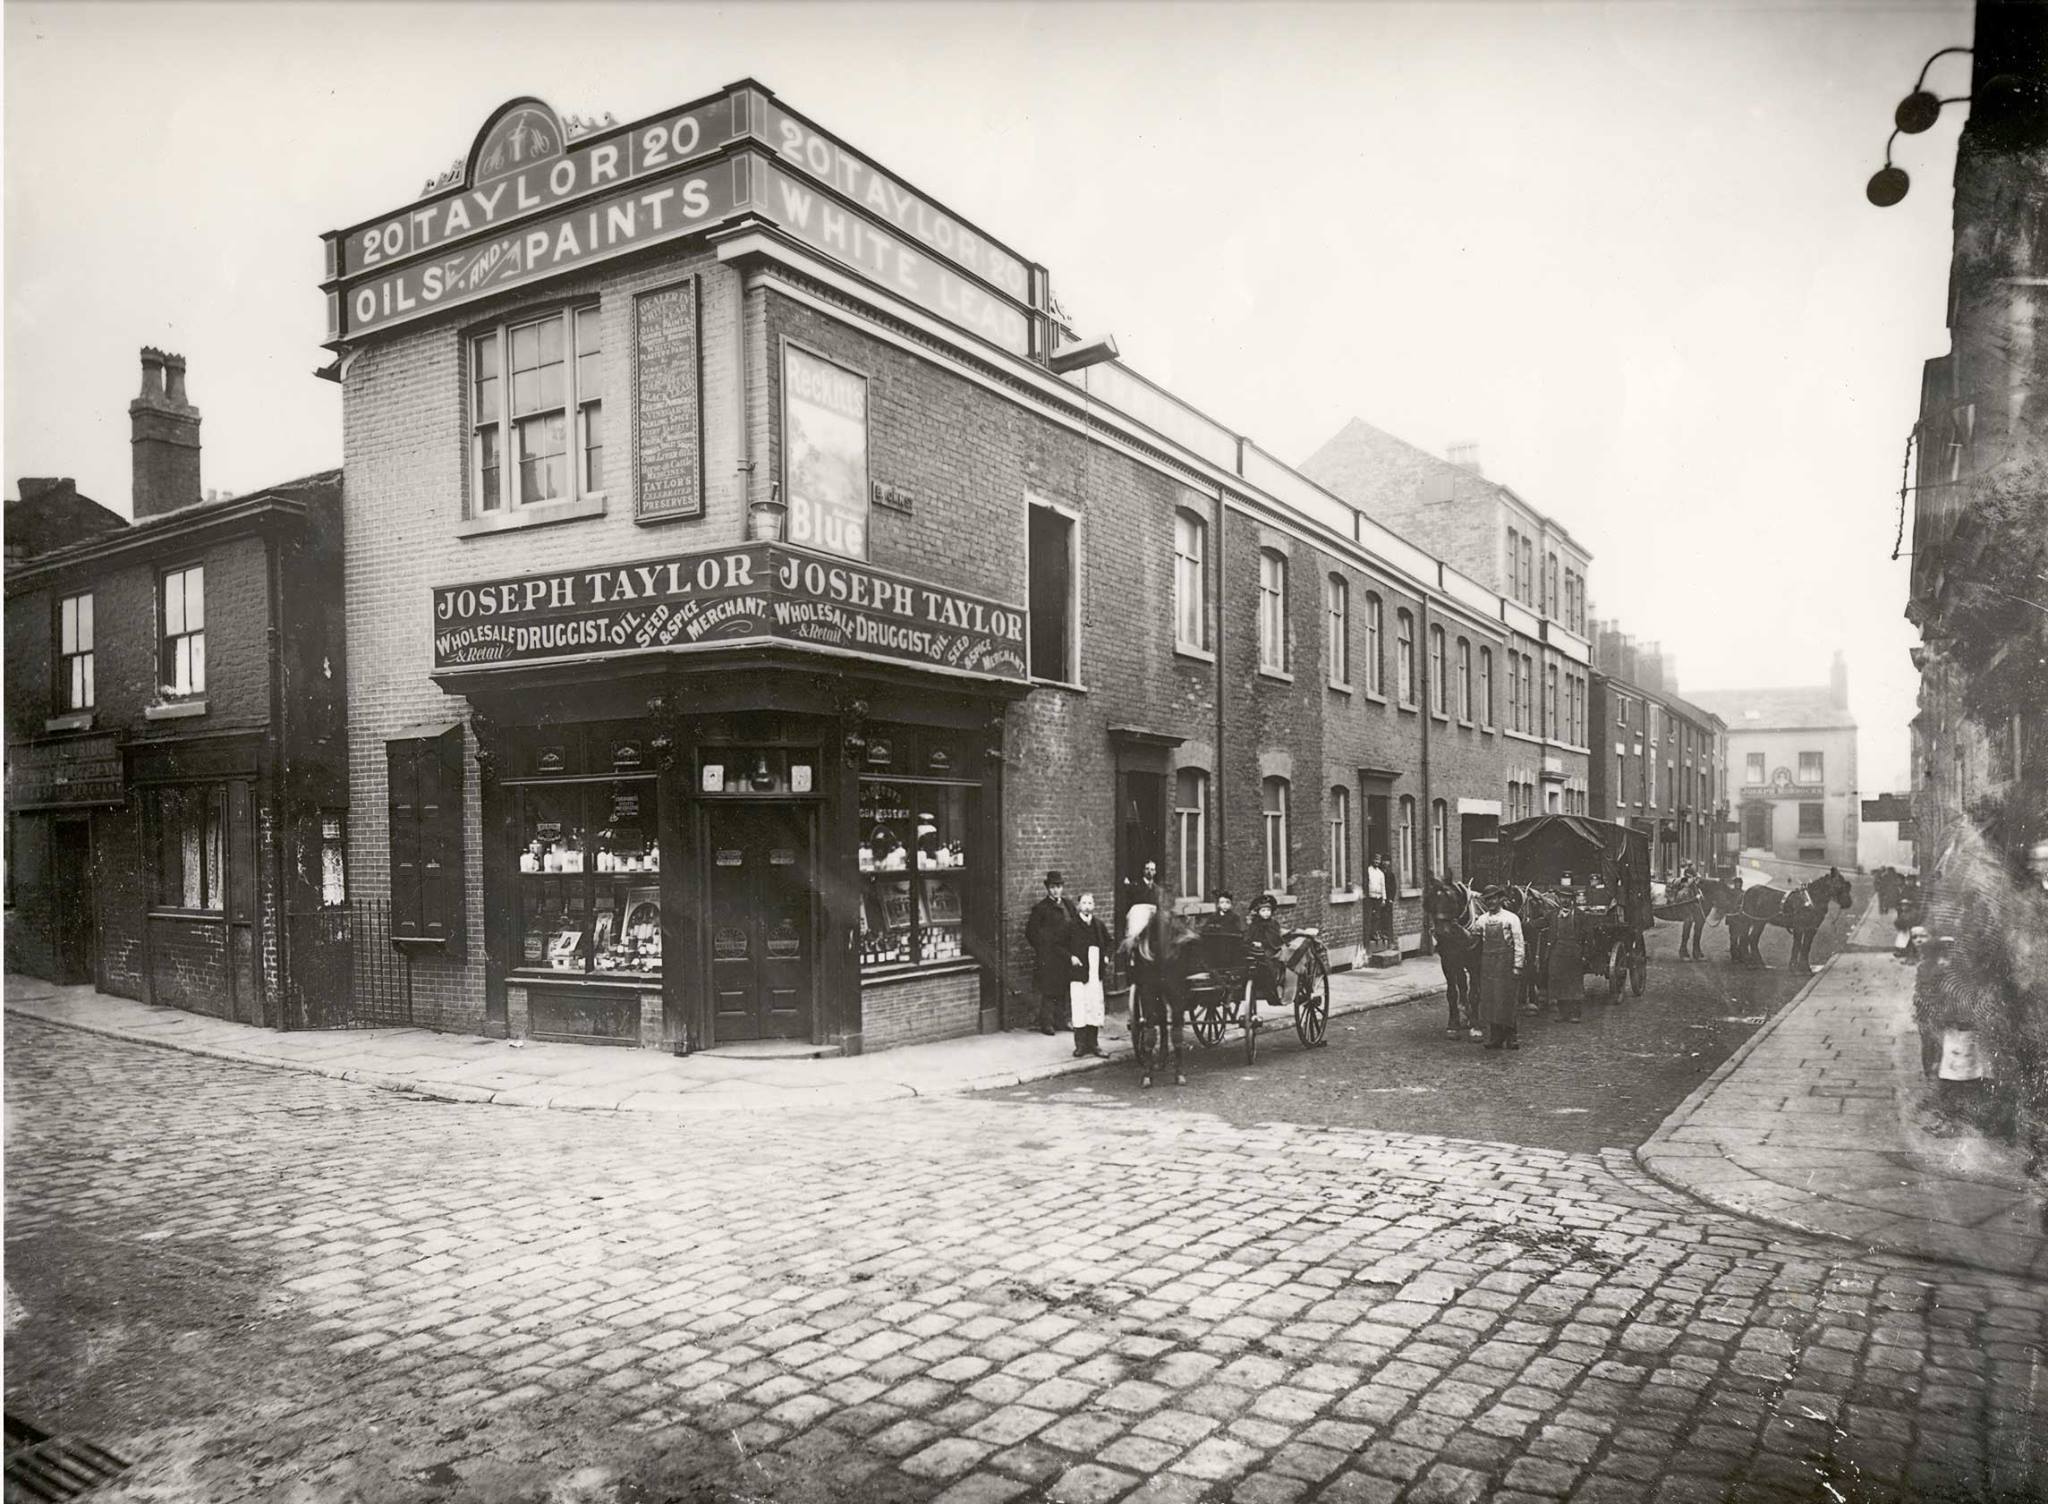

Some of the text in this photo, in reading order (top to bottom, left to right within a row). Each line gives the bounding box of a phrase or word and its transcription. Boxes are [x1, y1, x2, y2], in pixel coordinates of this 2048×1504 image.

[363, 117, 700, 264] 20 TAYLOR 20
[779, 119, 830, 177] 20
[838, 154, 977, 269] TAYLOR
[356, 180, 710, 322] OILS AND PAINTS
[781, 179, 1020, 344] WHITE LEAD
[788, 356, 864, 418] Reckitt's
[791, 495, 863, 556] Blue
[437, 554, 755, 620] JOSEPH TAYLOR
[668, 599, 699, 637] SPICE
[686, 596, 768, 642] MERCHANT.
[780, 558, 1024, 642] JOSEPH TAYLOR
[436, 625, 516, 657] WHOLESALE
[635, 604, 670, 649] SEED
[774, 601, 855, 639] WHOLESALE
[947, 635, 970, 666] SEED
